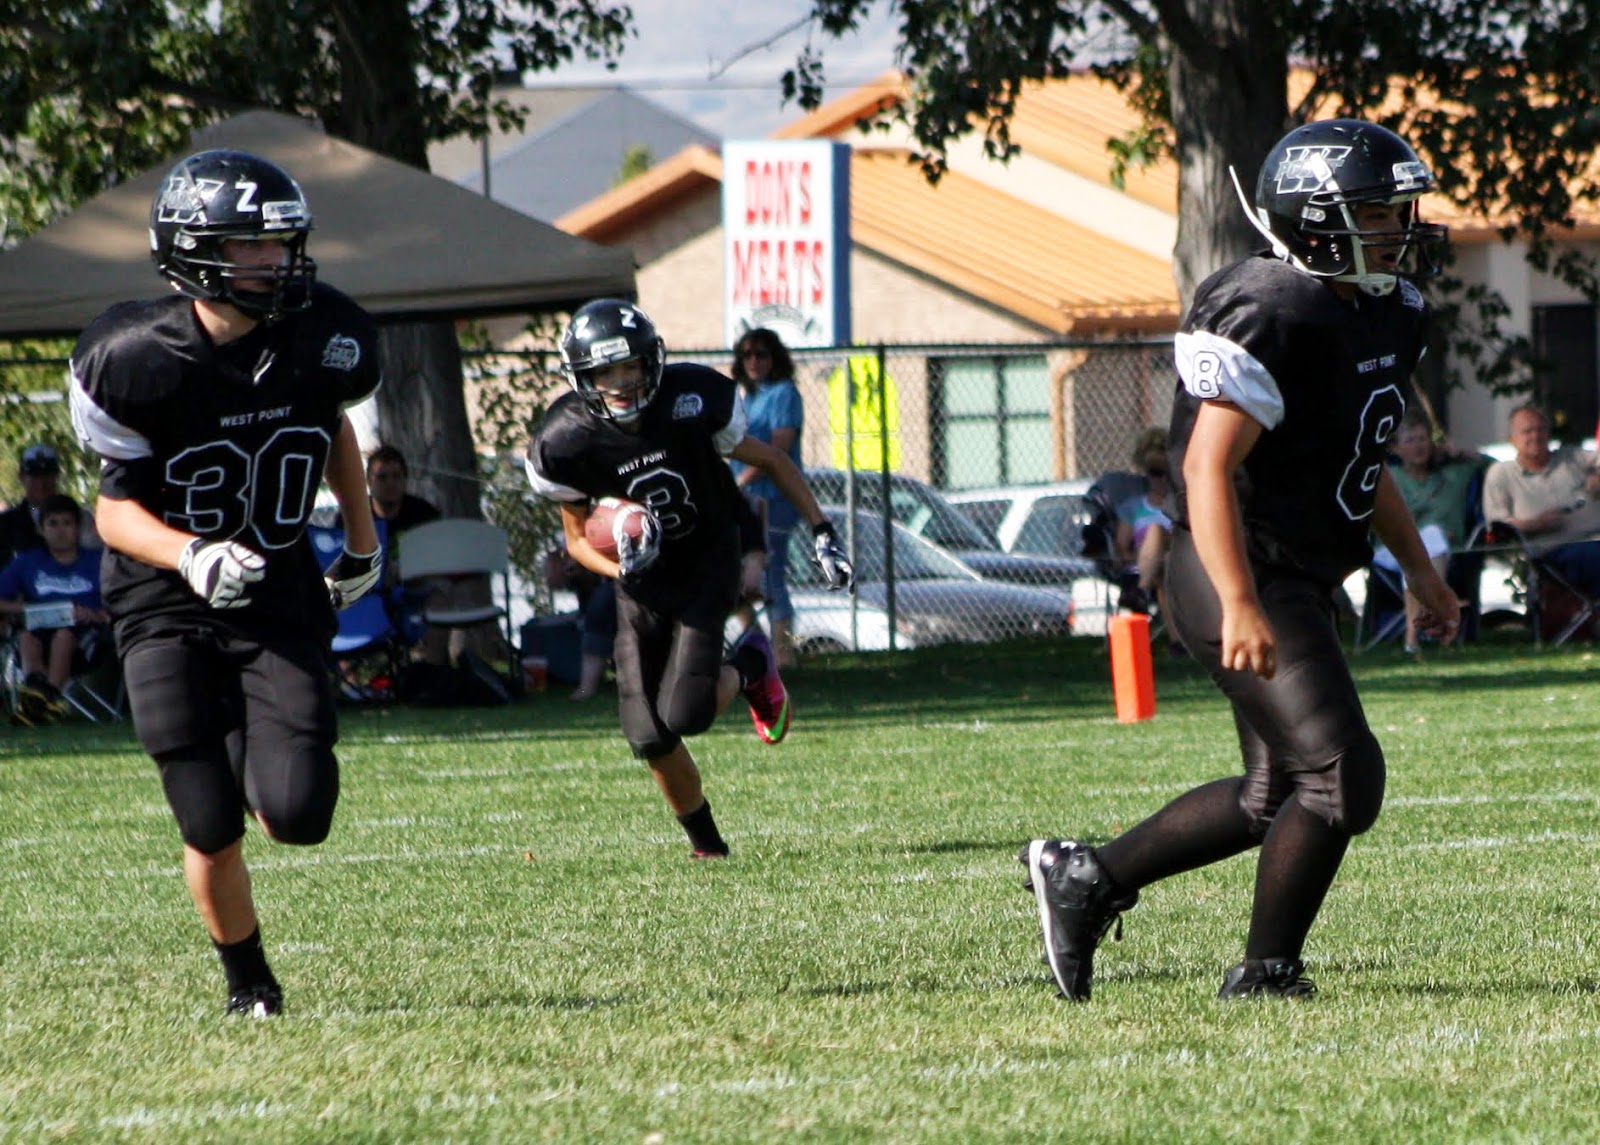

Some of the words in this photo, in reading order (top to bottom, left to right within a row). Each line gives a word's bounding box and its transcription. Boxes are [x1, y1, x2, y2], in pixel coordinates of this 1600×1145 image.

[235, 181, 259, 212] Z
[746, 161, 811, 224] DON'S
[733, 240, 823, 305] MEATS
[1193, 351, 1222, 398] 8
[1356, 358, 1378, 374] WEST
[219, 413, 254, 428] WEST
[258, 405, 293, 422] POINT
[617, 459, 641, 476] WEST
[642, 449, 668, 466] POINT
[1336, 383, 1406, 521] 8
[164, 425, 332, 550] 30
